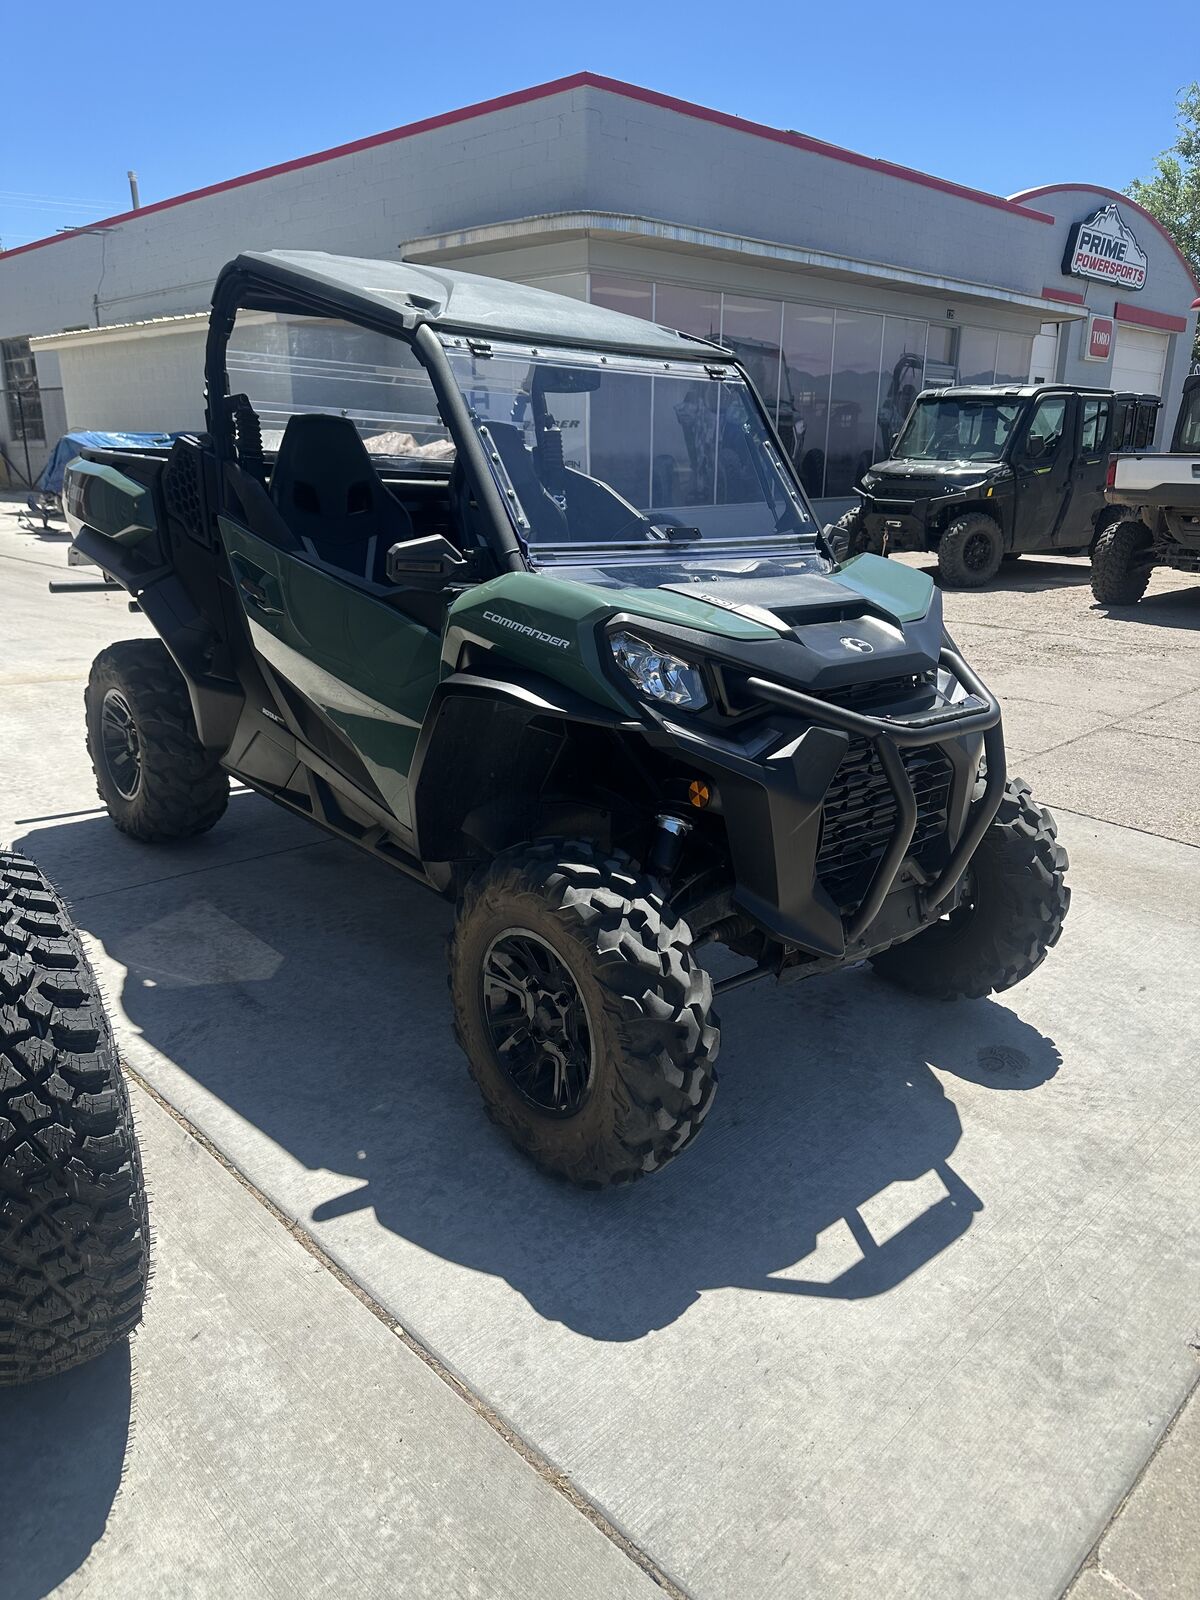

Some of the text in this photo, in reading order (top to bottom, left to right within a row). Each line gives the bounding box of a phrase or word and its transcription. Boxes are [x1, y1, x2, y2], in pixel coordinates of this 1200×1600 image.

[1079, 232, 1127, 261] PRIME
[1075, 253, 1144, 282] POWERSPORTS
[1092, 331, 1110, 346] TORO
[483, 611, 570, 648] COMMANDER
